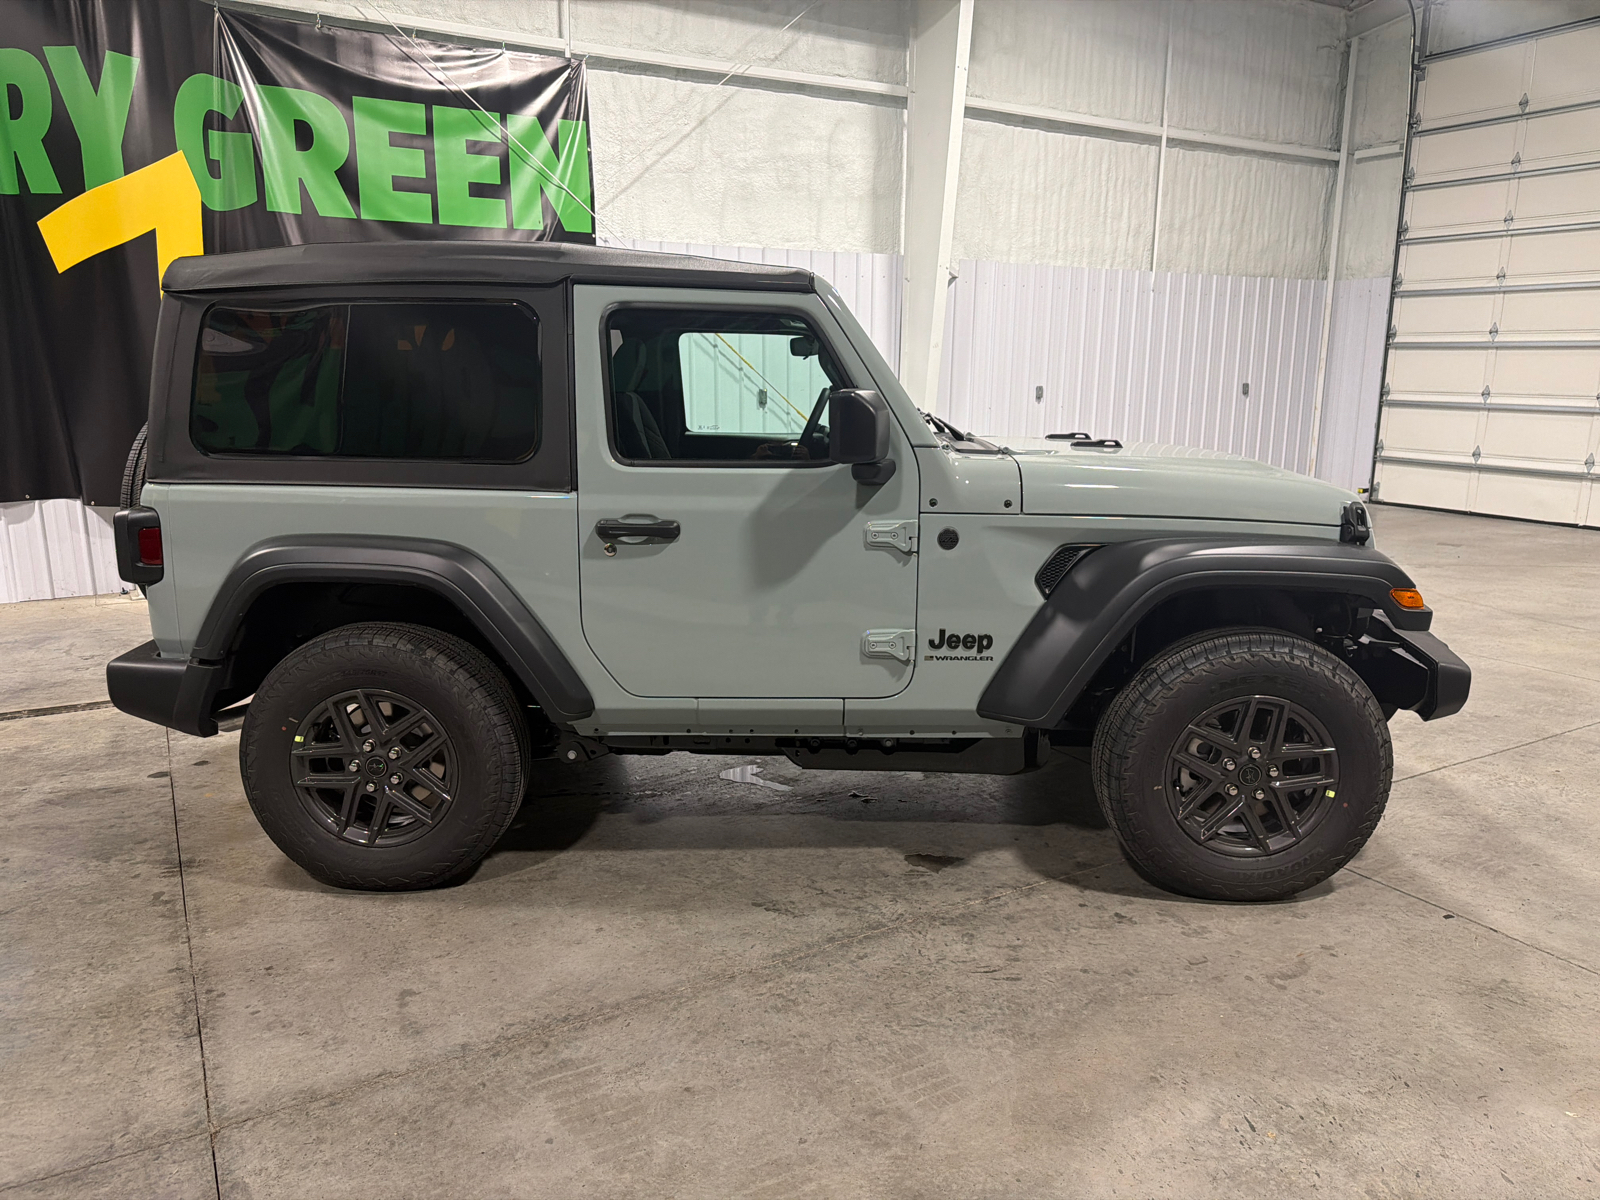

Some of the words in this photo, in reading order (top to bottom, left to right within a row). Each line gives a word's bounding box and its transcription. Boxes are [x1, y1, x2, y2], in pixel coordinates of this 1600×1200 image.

[0, 45, 140, 194] RY
[174, 73, 593, 234] GREEN
[928, 628, 993, 654] Jeep
